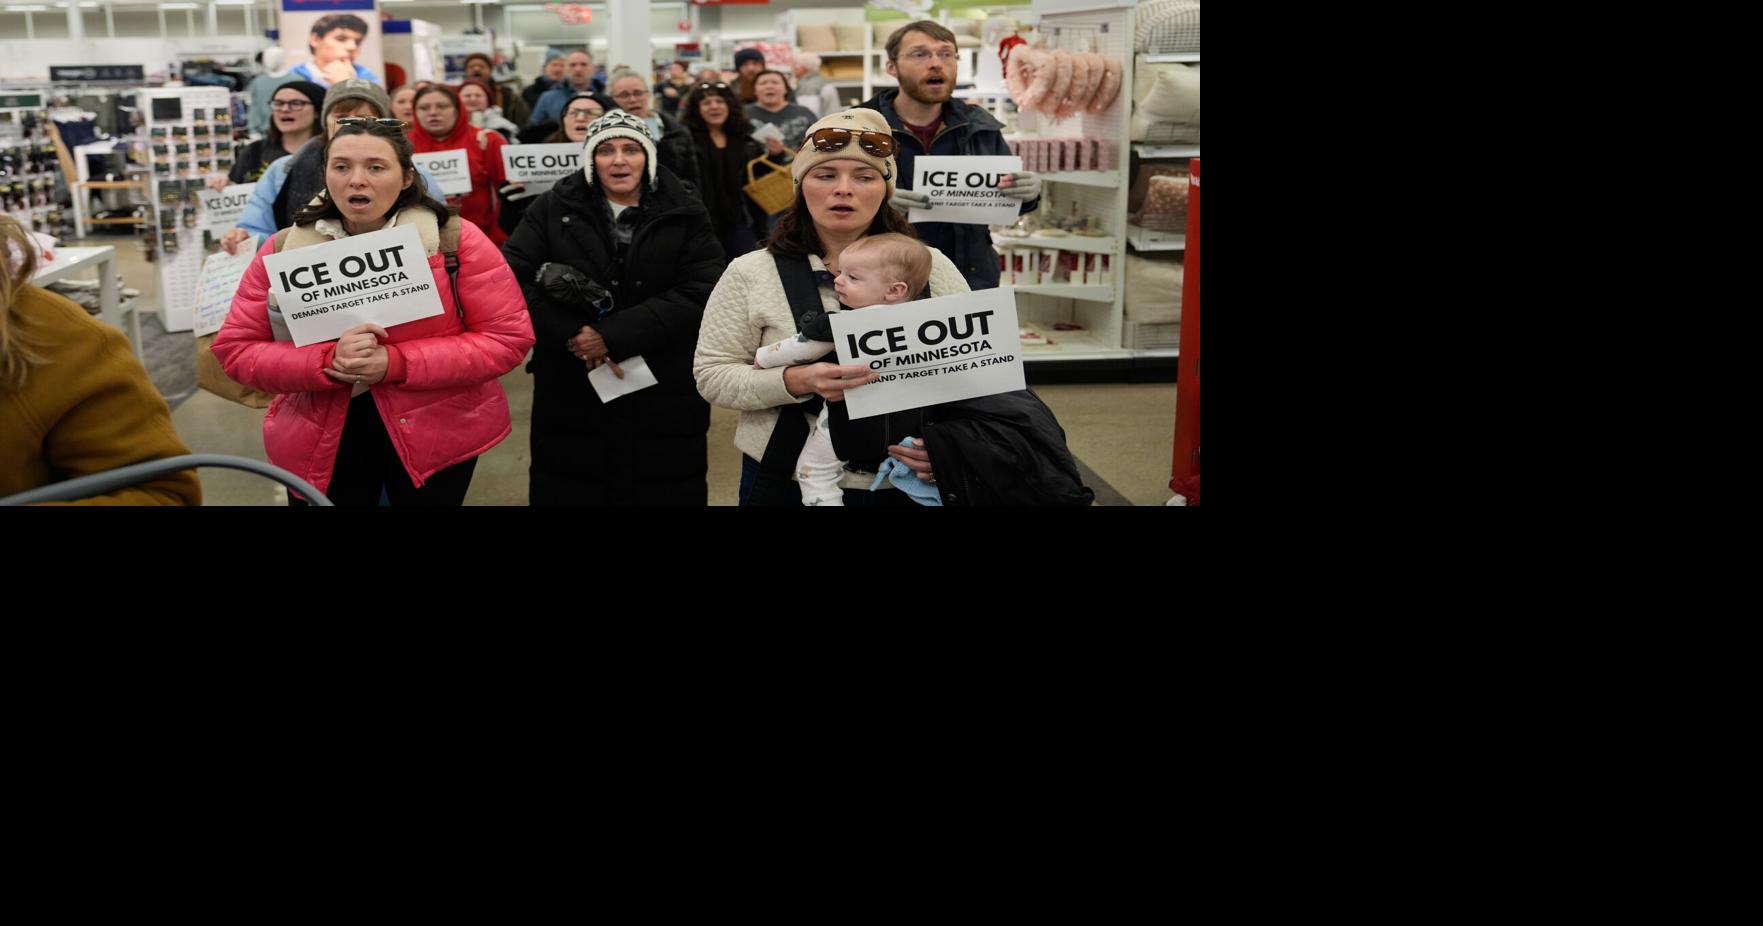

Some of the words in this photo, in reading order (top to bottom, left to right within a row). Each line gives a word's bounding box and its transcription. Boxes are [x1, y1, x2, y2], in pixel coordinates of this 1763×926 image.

[428, 158, 459, 171] OUT
[509, 155, 537, 169] ICE
[541, 153, 580, 168] OUT
[922, 171, 958, 187] ICE
[965, 172, 1009, 188] OU
[931, 189, 945, 197] OF
[223, 193, 248, 208] OUT
[279, 262, 332, 293] ICE
[339, 245, 404, 278] OUT
[301, 289, 321, 303] OF
[324, 271, 408, 298] MINNESOTA
[291, 306, 329, 320] DEMAND
[330, 298, 364, 312] TARGET
[366, 292, 391, 304] TAKE
[392, 291, 400, 299] A
[400, 283, 430, 296] STAND
[847, 326, 908, 359] ICE
[917, 310, 994, 346] OUT
[869, 357, 892, 370] OF
[896, 339, 992, 367] MINNESOTA
[898, 368, 940, 381] TARGET
[942, 363, 968, 375] TAKE
[970, 361, 979, 369] A
[980, 354, 1014, 367] STAND
